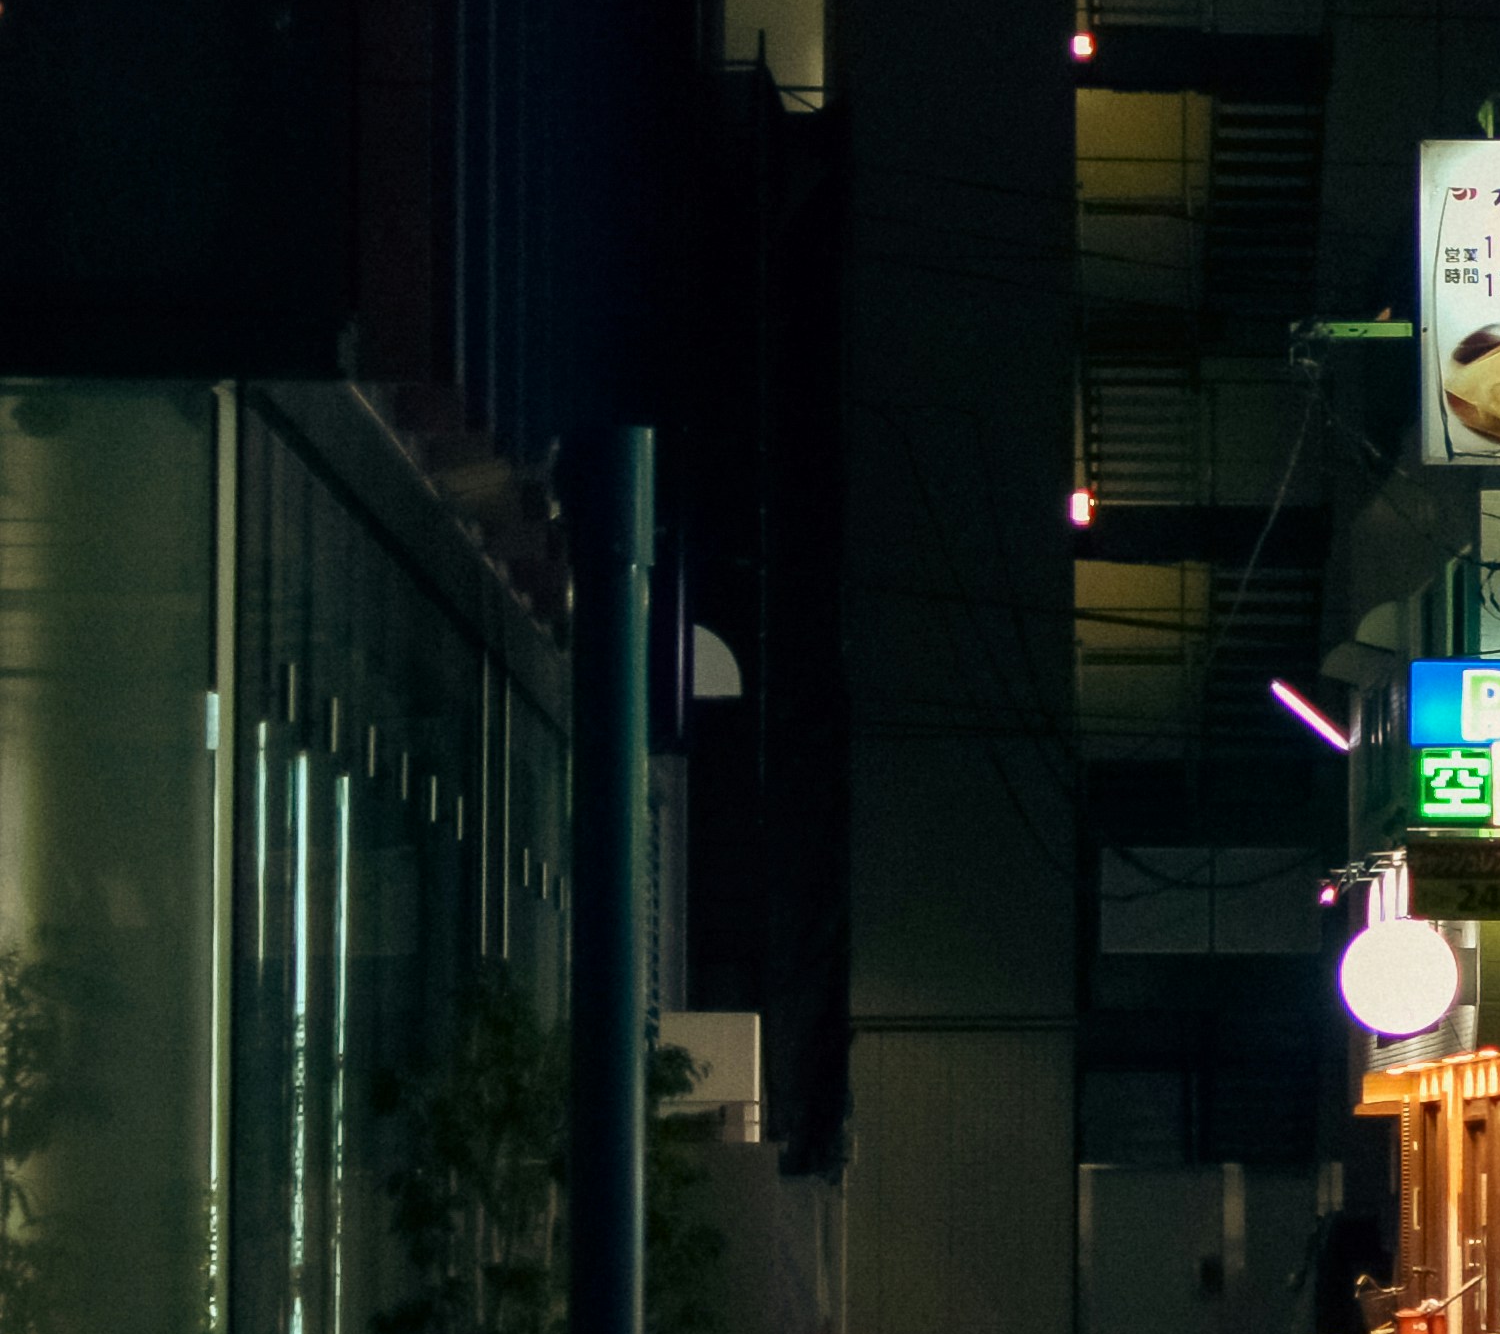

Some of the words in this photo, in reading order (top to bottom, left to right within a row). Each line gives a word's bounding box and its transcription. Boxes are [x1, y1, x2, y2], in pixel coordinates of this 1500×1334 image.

[1445, 248, 1478, 263] 営業
[1445, 269, 1480, 284] 時間
[1423, 750, 1492, 816] 空
